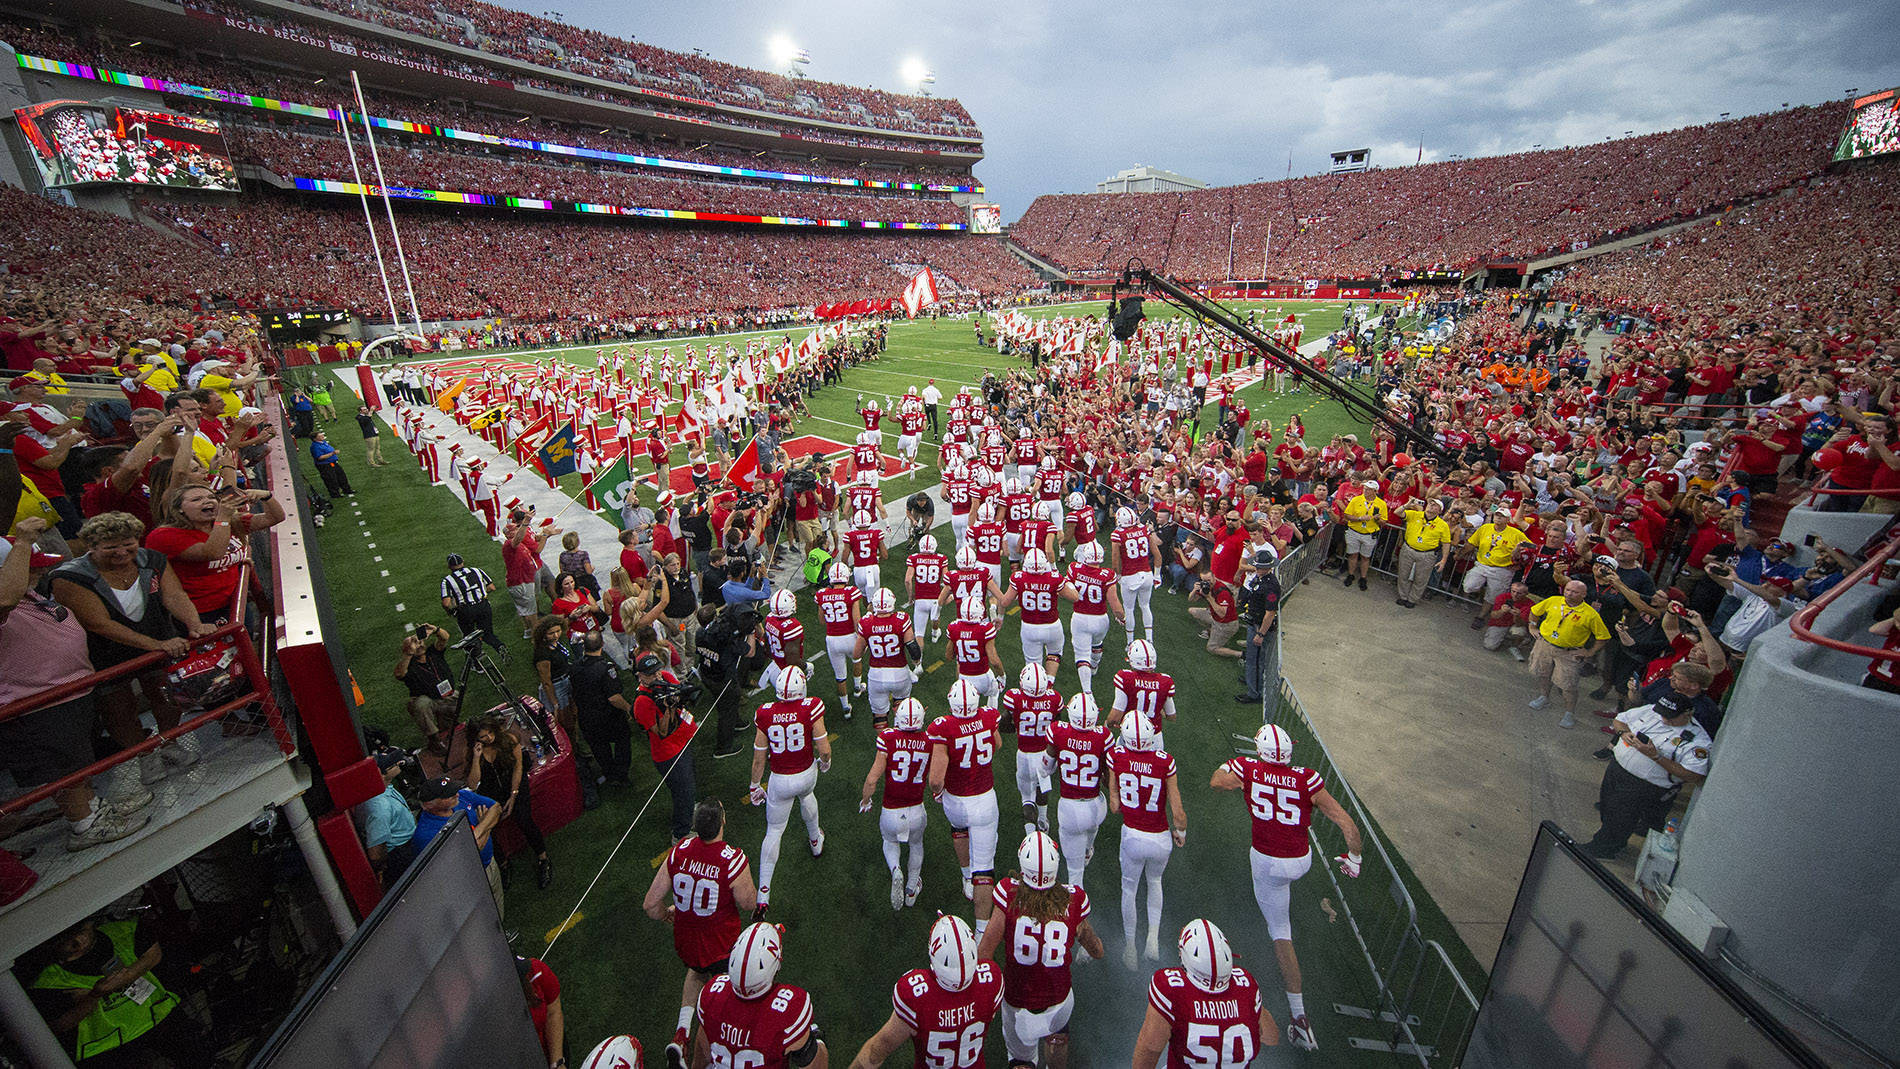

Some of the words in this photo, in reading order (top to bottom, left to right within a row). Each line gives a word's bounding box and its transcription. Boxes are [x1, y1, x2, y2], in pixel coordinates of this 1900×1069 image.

[225, 17, 267, 35] NCAA
[273, 29, 326, 48] RECORD
[362, 50, 438, 74] CONSECUTIVE
[442, 69, 489, 85] SELLOUTS
[857, 449, 874, 464] 76
[989, 452, 1004, 466] 57
[1018, 445, 1034, 458] 75
[950, 487, 968, 503] 35
[1043, 479, 1062, 493] 38
[852, 494, 873, 510] 47
[1010, 502, 1031, 520] 65
[1085, 516, 1094, 533] 2
[978, 535, 1001, 552] 39
[1024, 529, 1037, 548] 11
[1125, 536, 1149, 559] 83
[859, 540, 871, 558] 5
[916, 565, 940, 584] 98
[956, 581, 984, 600] 44
[1075, 580, 1102, 604] 70
[1022, 590, 1052, 612] 66
[821, 601, 849, 623] 32
[871, 625, 893, 633] CONRAD
[868, 634, 900, 658] 62
[956, 640, 980, 663] 15
[1134, 679, 1160, 690] MASKER
[1022, 700, 1029, 709] M.
[1032, 700, 1051, 711] JONES
[1136, 690, 1158, 718] 11
[773, 712, 798, 723] ROGERS
[960, 719, 983, 734] HIXSON
[1019, 711, 1053, 737] 26
[767, 722, 805, 754] 98
[896, 739, 926, 750] MAZOUR
[1067, 738, 1092, 751] OZIGBO
[954, 730, 993, 769] 75
[891, 751, 930, 784] 37
[1059, 750, 1100, 788] 22
[1129, 760, 1153, 774] YOUNG
[1252, 769, 1260, 781] C.
[1264, 772, 1297, 788] WALKER
[1118, 772, 1162, 812] 87
[1251, 782, 1301, 825] 55
[680, 858, 687, 871] J.
[688, 860, 720, 879] WALKER
[673, 872, 719, 917] 90
[1013, 915, 1069, 968] 68
[938, 1002, 975, 1027] SHEFKE
[1193, 999, 1239, 1019] RARIDON
[720, 1022, 750, 1047] STOLL
[925, 1021, 986, 1069] 56
[1183, 1022, 1254, 1069] 50
